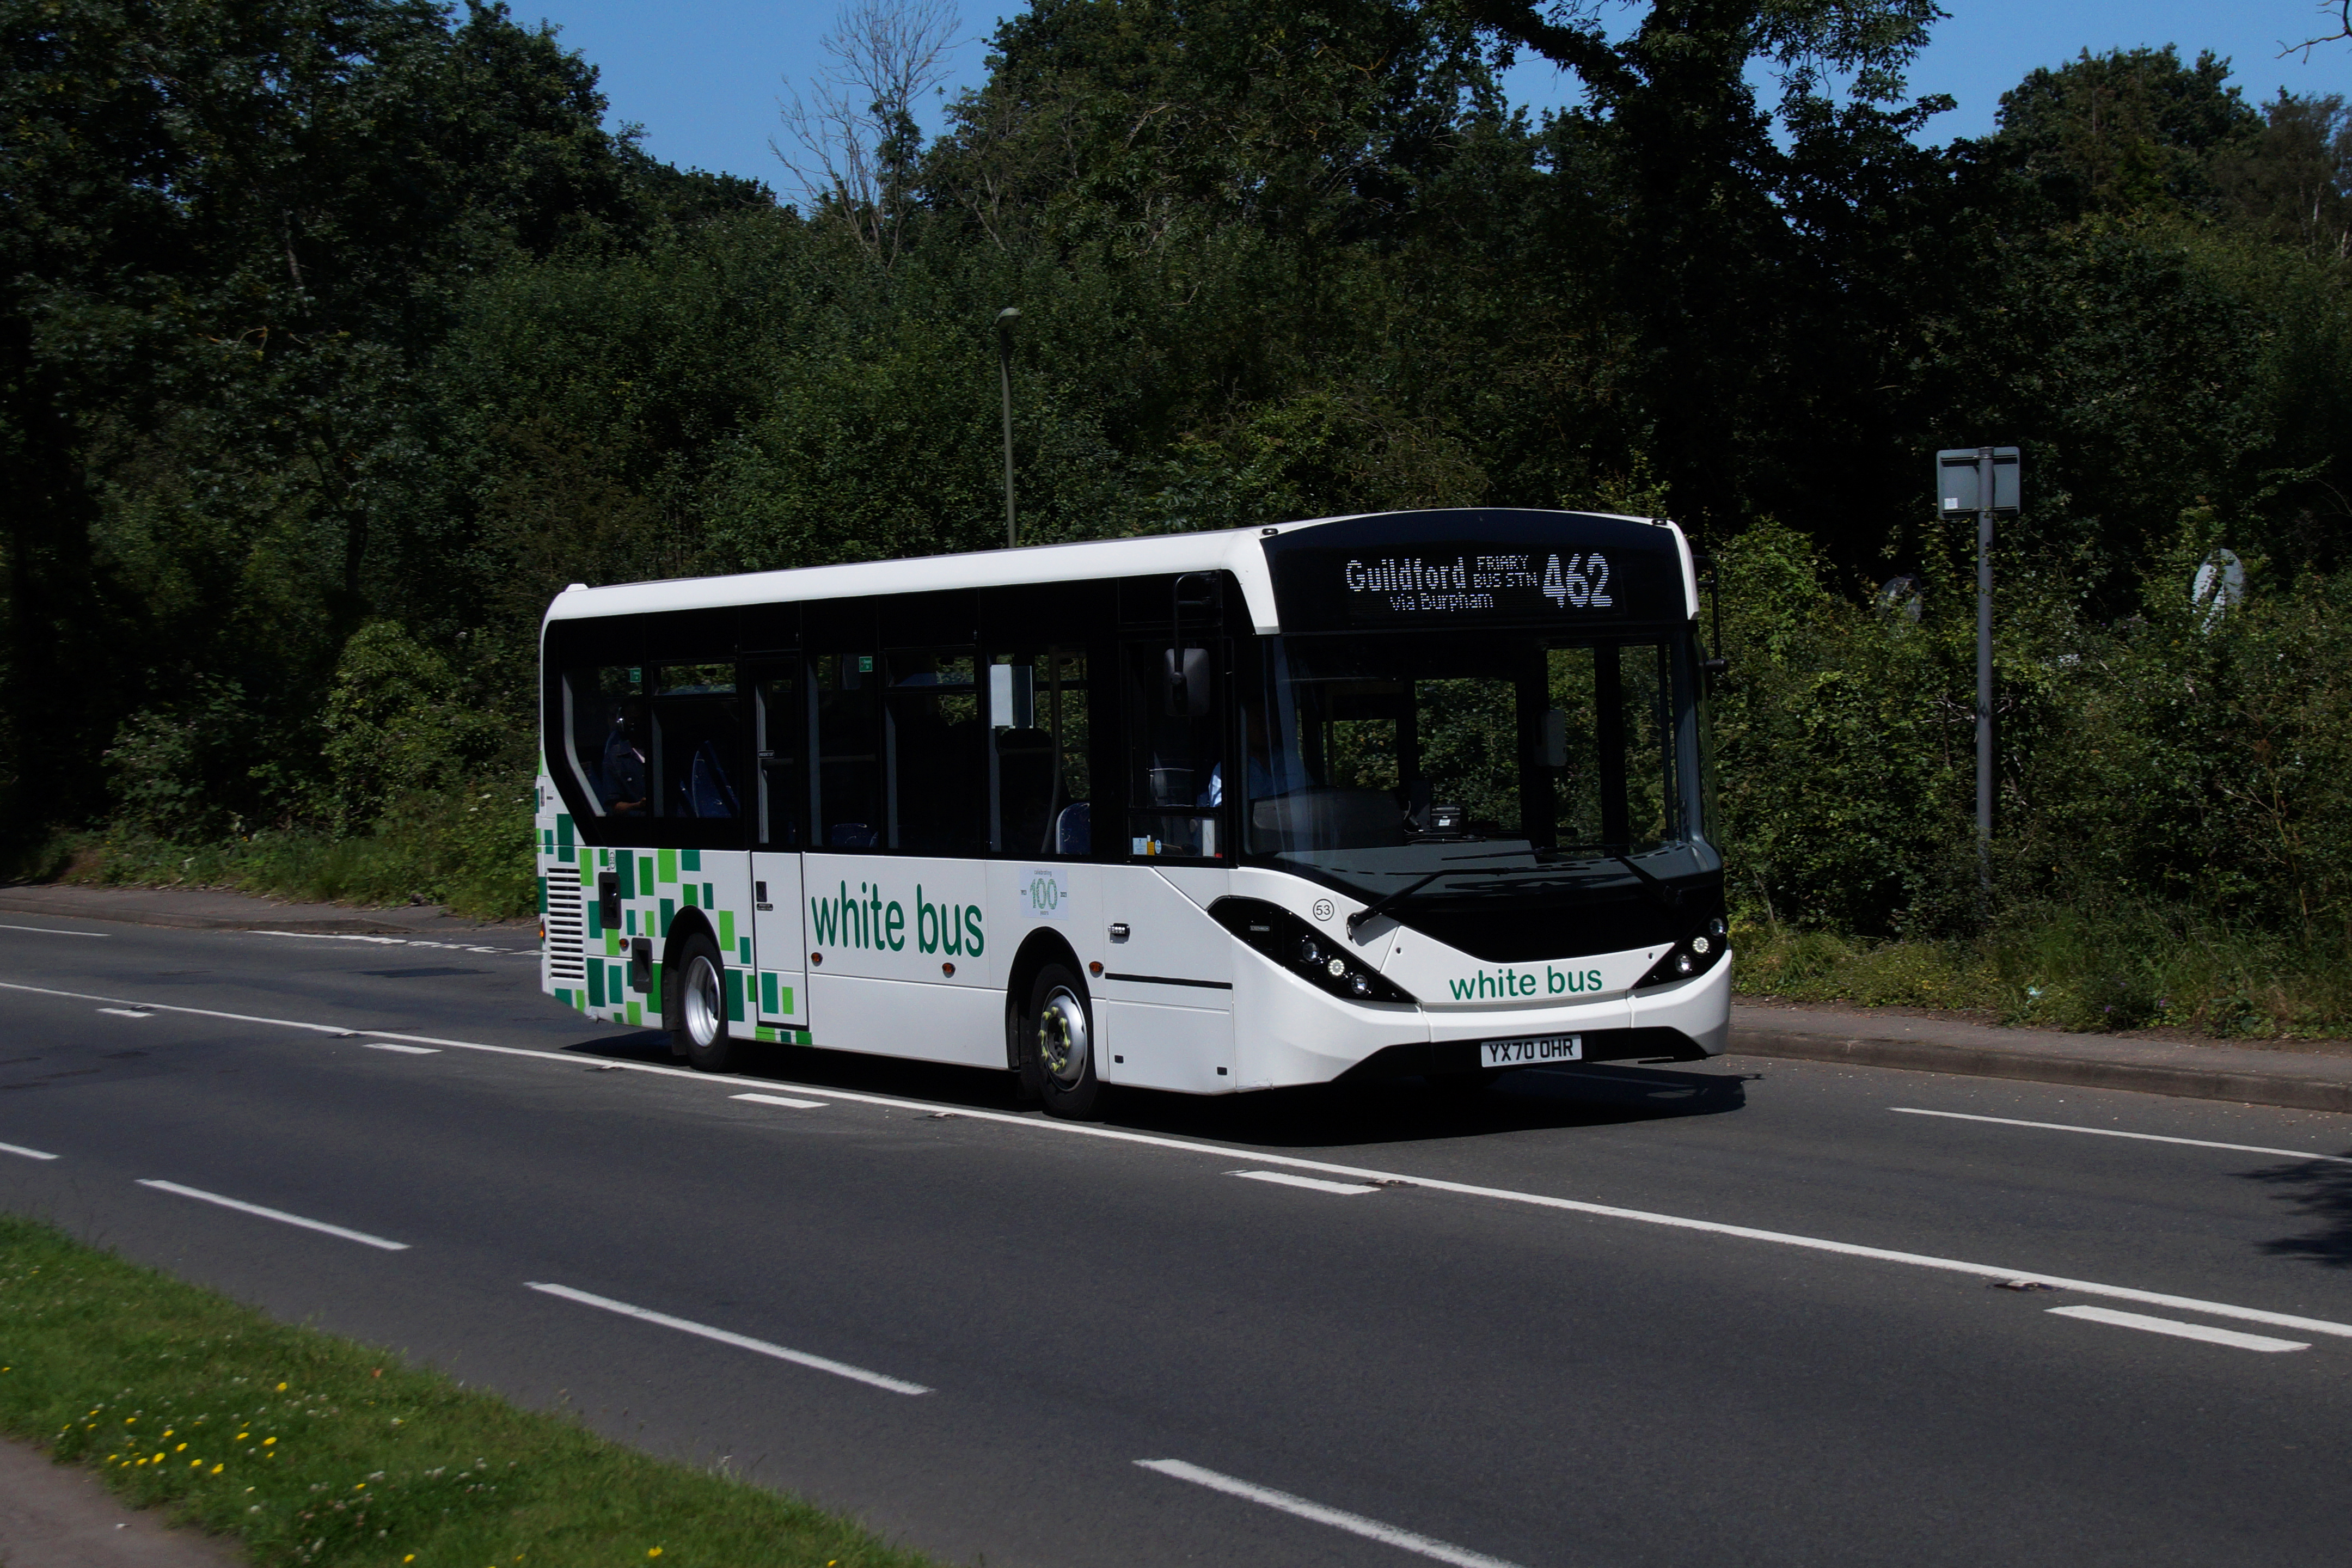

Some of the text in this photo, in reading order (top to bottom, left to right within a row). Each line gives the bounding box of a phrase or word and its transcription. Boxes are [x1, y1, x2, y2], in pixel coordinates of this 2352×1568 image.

[1346, 558, 1466, 591] Guildford
[1477, 555, 1529, 571] FRIARY
[1473, 572, 1538, 588] BUS STN
[1542, 553, 1613, 608] 462
[1389, 591, 1493, 611] via Burpham
[1030, 878, 1058, 910] 100
[811, 880, 984, 958] white bus
[1316, 904, 1331, 916] 53
[1449, 965, 1602, 1001] white bus
[1489, 1038, 1574, 1062] YX70 OHR
